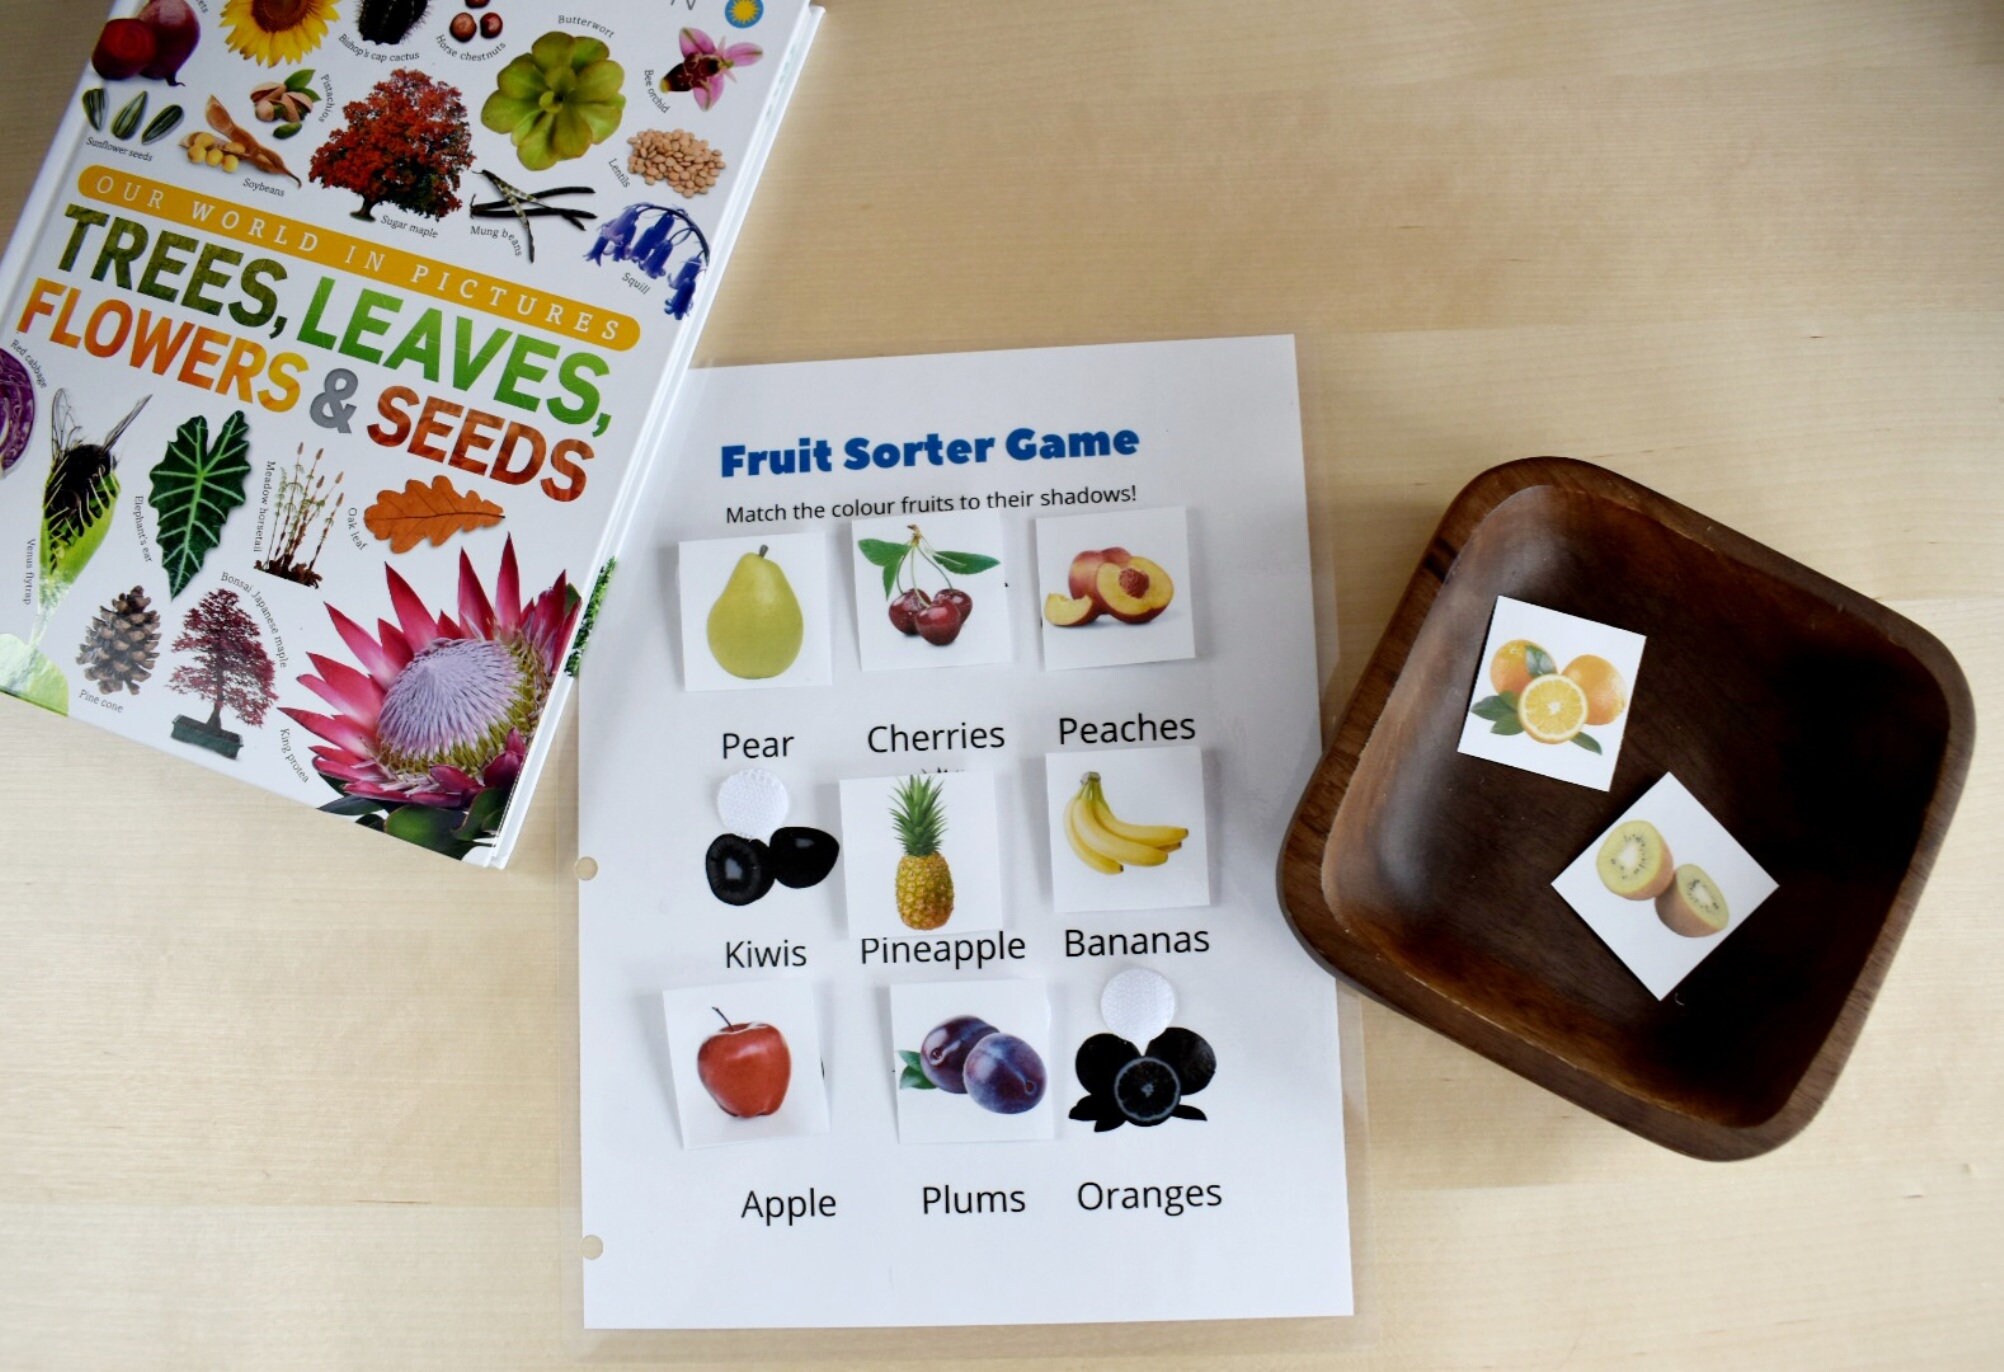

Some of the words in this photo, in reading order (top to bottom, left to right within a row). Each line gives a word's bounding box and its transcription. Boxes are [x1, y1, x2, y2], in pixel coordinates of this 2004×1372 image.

[558, 14, 614, 38] Butterwort
[338, 33, 369, 58] Bishop's
[371, 52, 387, 63] cap
[389, 51, 420, 62] cactus
[436, 34, 457, 57] Horse
[460, 42, 507, 62] chestnuts
[644, 69, 654, 87] Bee
[318, 73, 336, 123] Pistachios
[648, 88, 670, 114] orchid
[86, 136, 128, 154] Sunflower
[128, 147, 153, 162] seeds
[243, 177, 285, 198] Soybeans
[608, 158, 631, 188] Lentils
[381, 215, 406, 230] Sugar
[409, 224, 439, 239] maple
[470, 225, 499, 239] Mung
[502, 228, 522, 256] beans
[96, 175, 165, 209] OUR
[191, 200, 319, 254] WORLD
[345, 246, 386, 273] IN
[410, 264, 621, 341] PICTURES
[622, 272, 652, 295] Squill
[58, 203, 288, 339] TREES,
[296, 276, 612, 437] LEAVES,
[11, 339, 27, 356] Red
[25, 355, 47, 389] cabbage
[16, 277, 309, 412] FLOWERS
[309, 367, 359, 434] &
[367, 384, 595, 502] SEEDS
[721, 437, 832, 478] Fruit
[843, 432, 995, 471] Sorter
[1005, 427, 1140, 462] Game
[262, 461, 276, 505] Meadow
[348, 507, 358, 530] Oak
[726, 503, 787, 524] Match
[793, 500, 825, 520] the
[831, 496, 895, 518] colour
[901, 494, 954, 514] fruits
[960, 495, 981, 510] to
[986, 489, 1034, 509] their
[1040, 485, 1137, 507] shadows!
[133, 496, 150, 546] Elephant's
[142, 544, 153, 562] ear
[253, 508, 269, 552] horsetail
[350, 531, 368, 551] leaf
[26, 538, 36, 568] Venus
[23, 572, 35, 605] flytrap
[221, 571, 252, 593] Bonsai
[251, 591, 279, 634] Japanese
[274, 636, 289, 668] maple
[79, 689, 99, 704] Pine
[100, 699, 124, 714] cone
[280, 728, 292, 754] King
[868, 721, 1005, 754] Cherries
[1059, 713, 1196, 745] Peaches
[722, 732, 794, 759] Pear
[285, 753, 309, 783] protea
[726, 939, 807, 968] Kiwis
[861, 930, 1026, 970] Pineapple
[1065, 929, 1210, 958] Bananas
[741, 1188, 837, 1226] Apple
[923, 1185, 1026, 1214] Plums
[1077, 1181, 1223, 1216] Oranges
